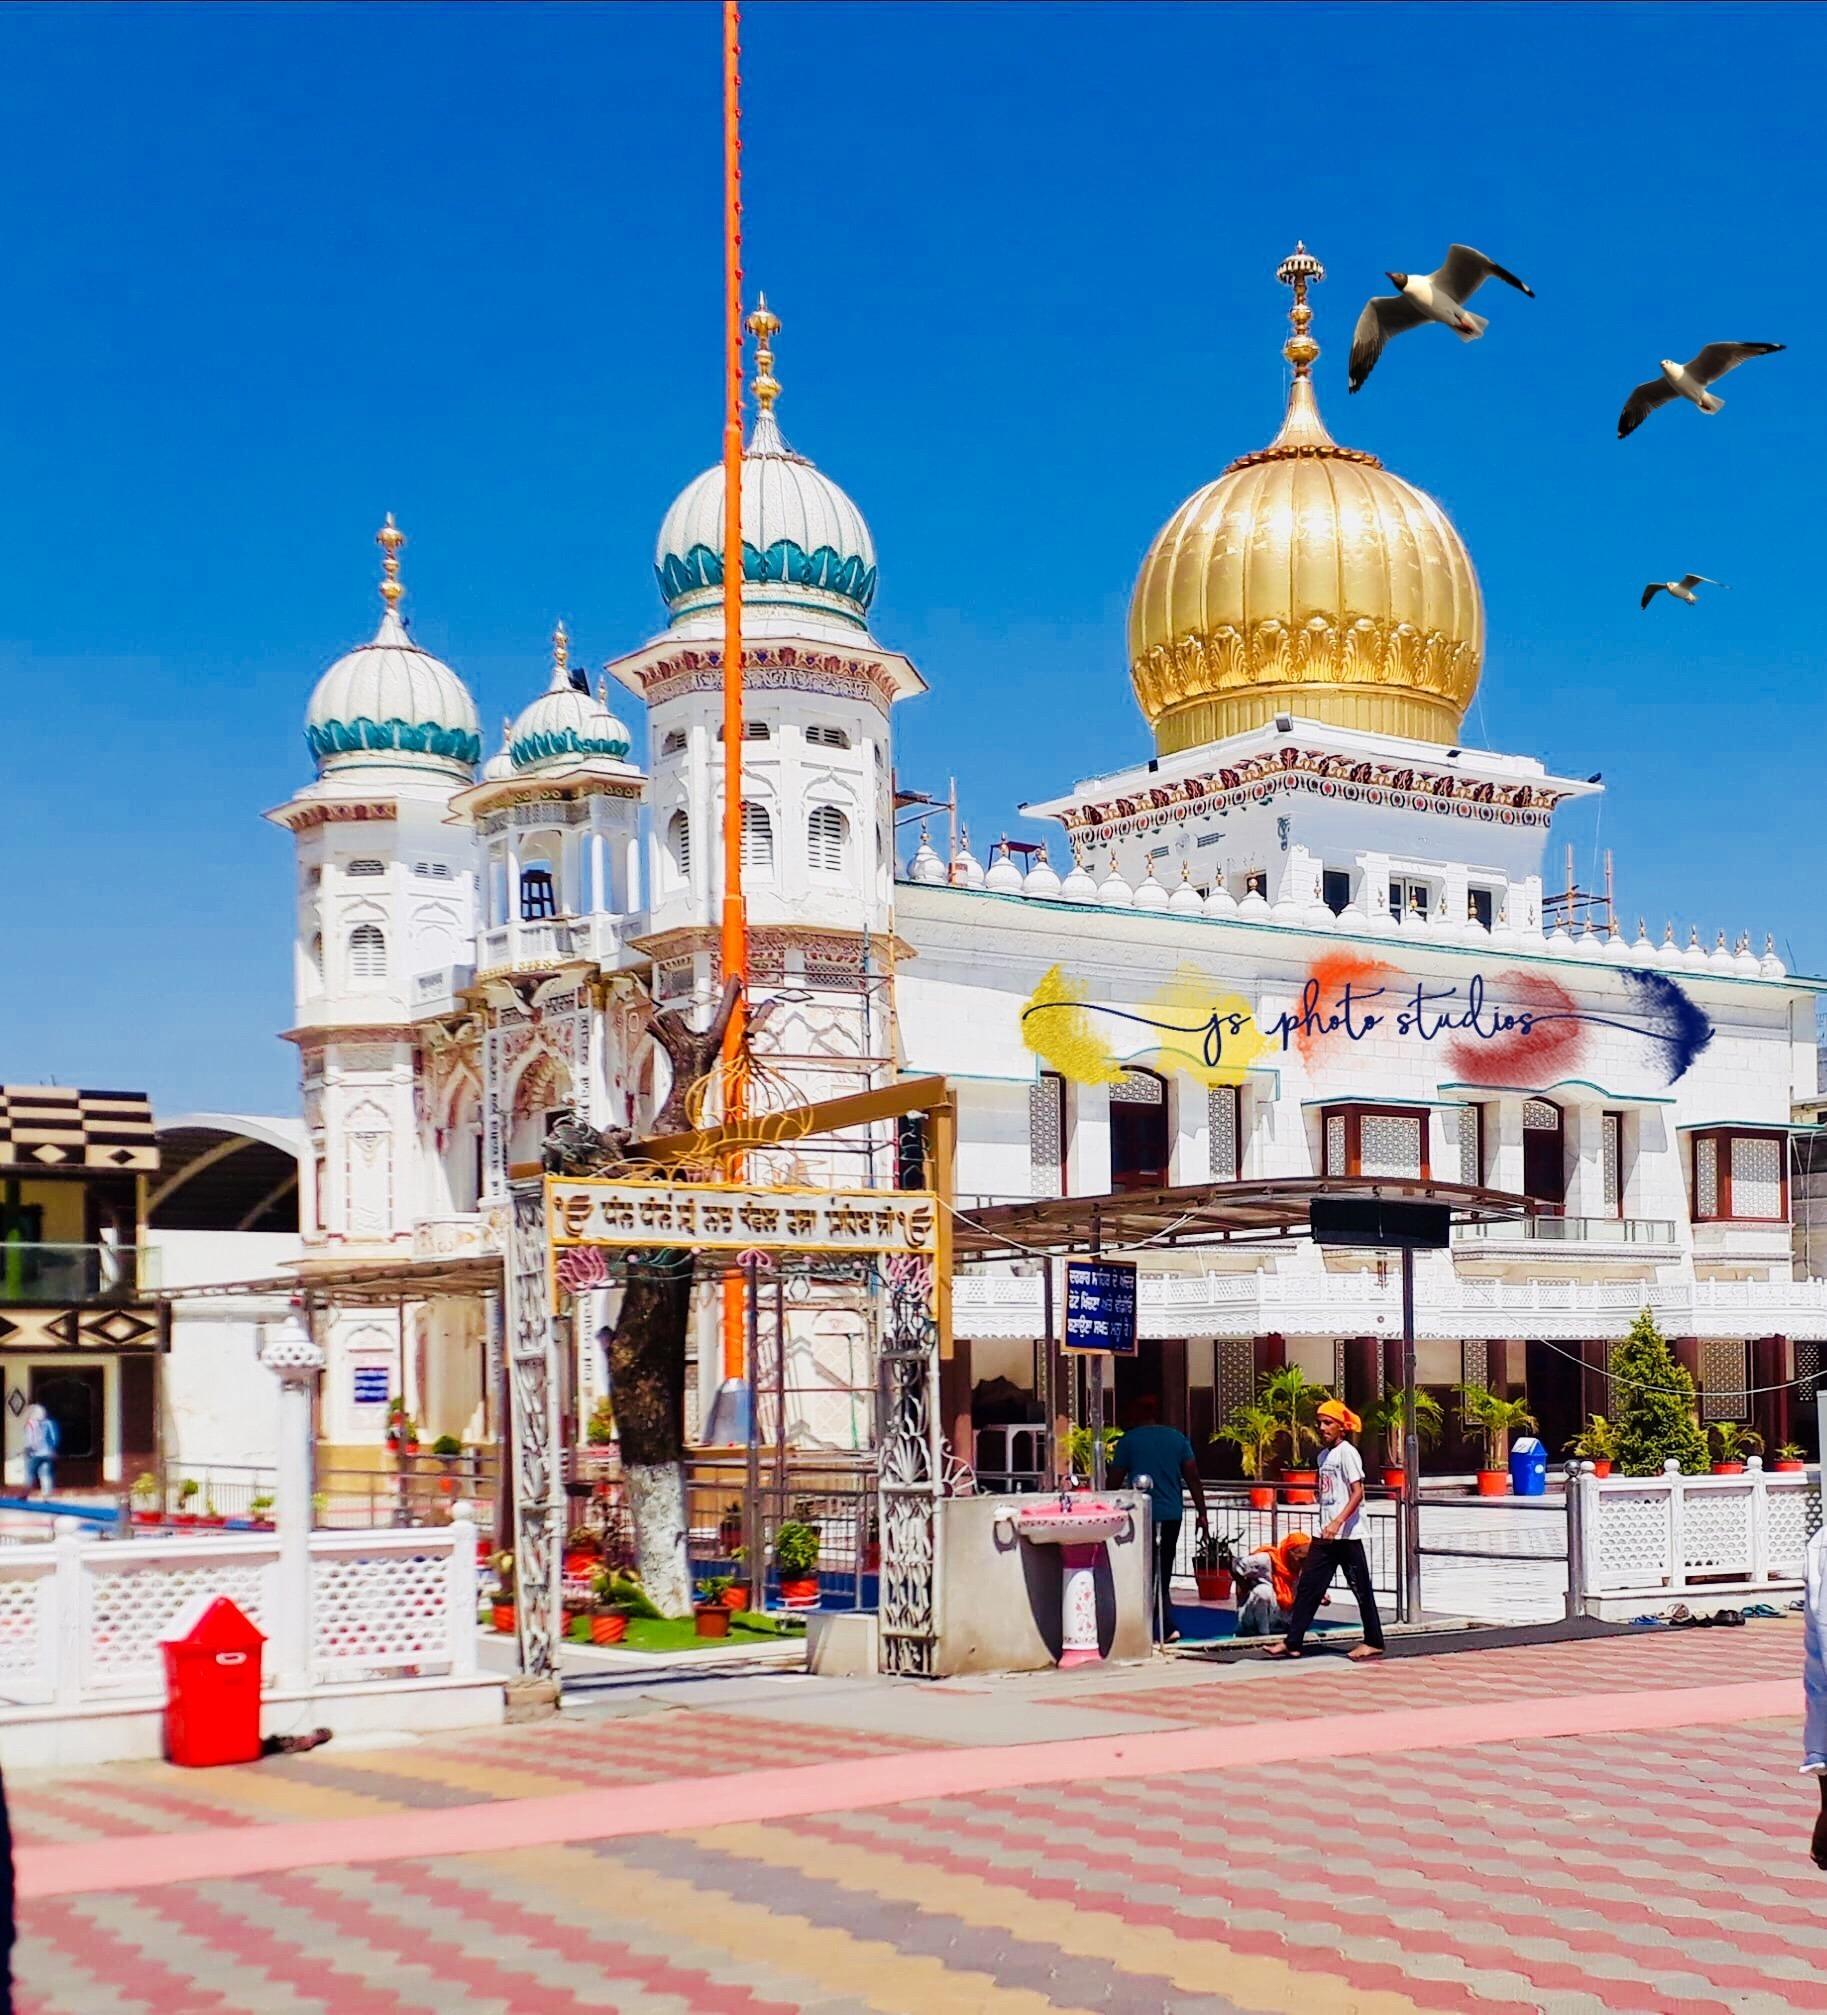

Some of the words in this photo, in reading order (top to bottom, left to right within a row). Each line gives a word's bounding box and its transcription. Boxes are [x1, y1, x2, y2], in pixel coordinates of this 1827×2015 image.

[600, 1195, 634, 1229] ਧੰਨ
[638, 1196, 672, 1231] ਧੰਨ
[676, 1198, 697, 1236] ਸ੍ਰੀ
[824, 1203, 873, 1237] ਸਾਹਿਬ
[875, 1206, 896, 1237] ਜੀ
